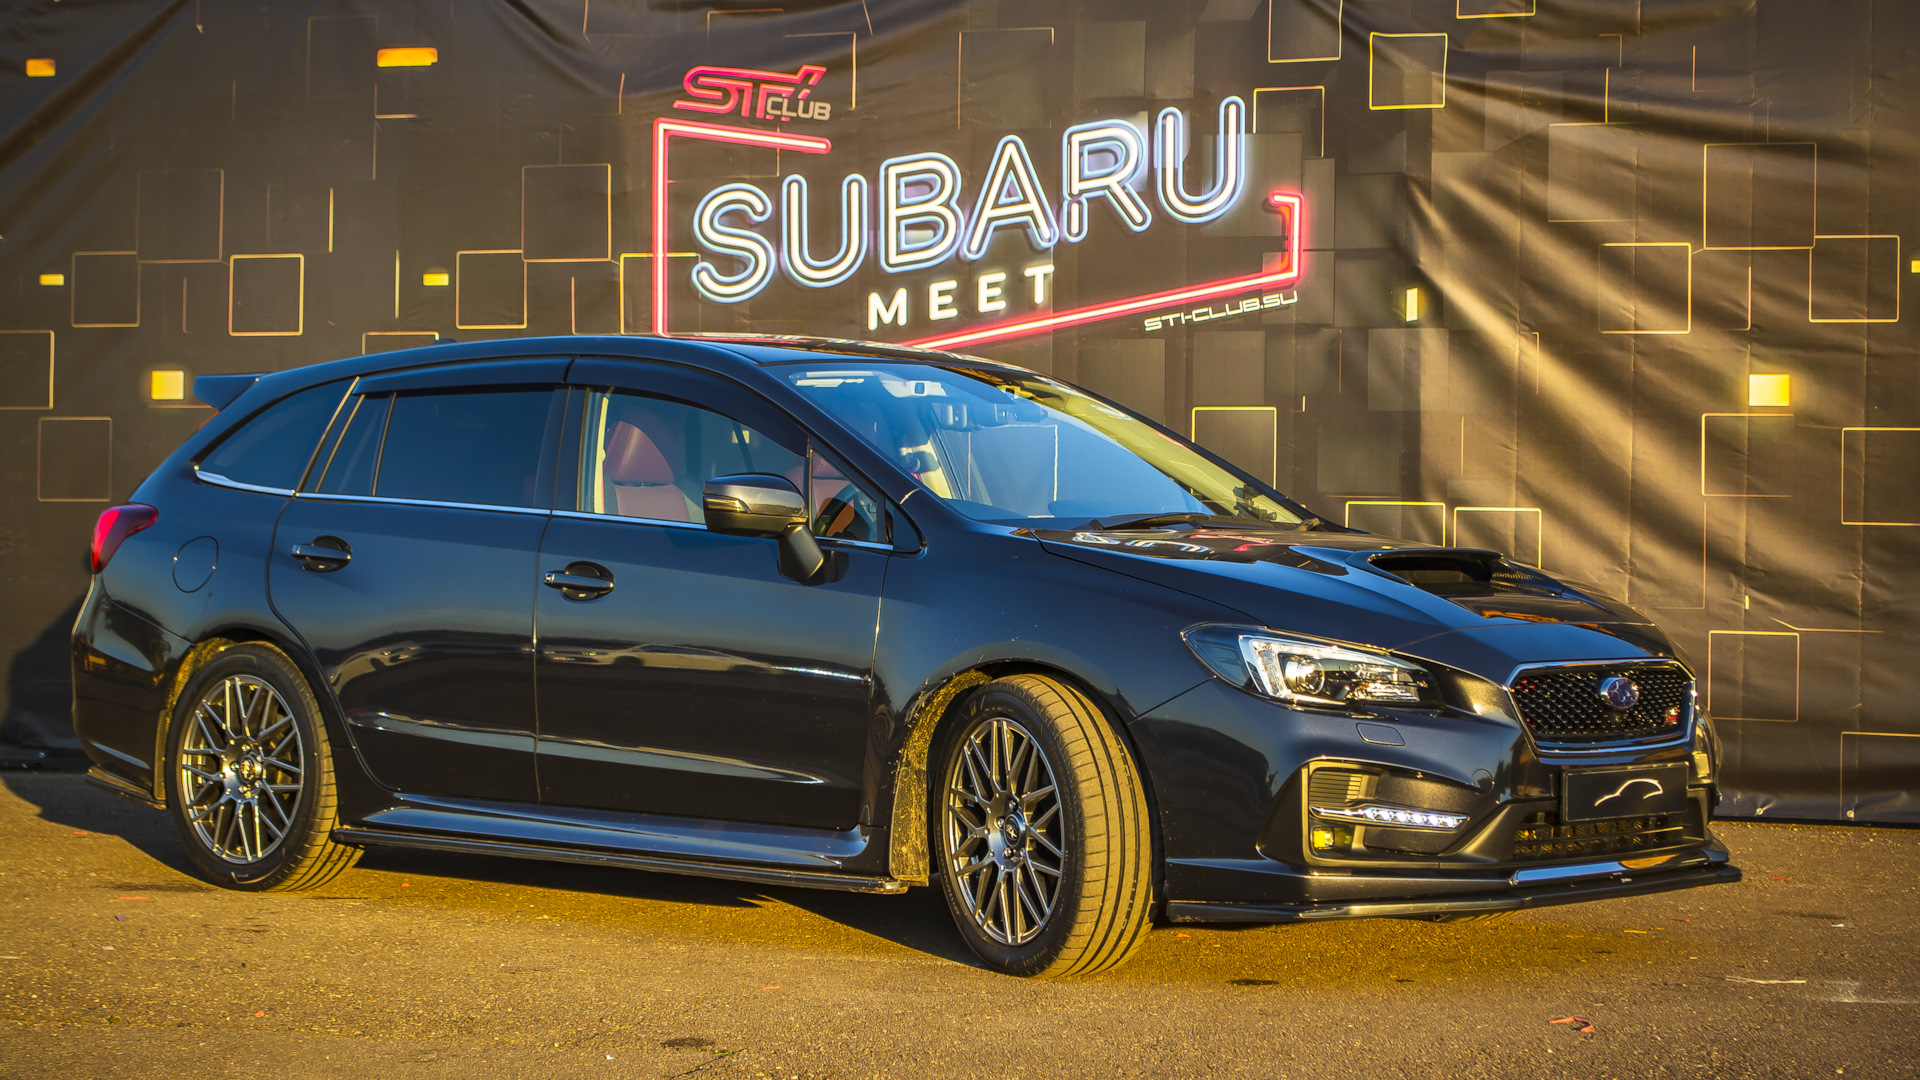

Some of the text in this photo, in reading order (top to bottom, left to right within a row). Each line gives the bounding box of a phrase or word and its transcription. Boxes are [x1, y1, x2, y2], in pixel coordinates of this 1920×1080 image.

[766, 96, 831, 121] CLUB
[691, 95, 1246, 304] SUBARU
[868, 264, 1055, 331] MEET
[1144, 290, 1298, 332] STI-CLUB.SU
